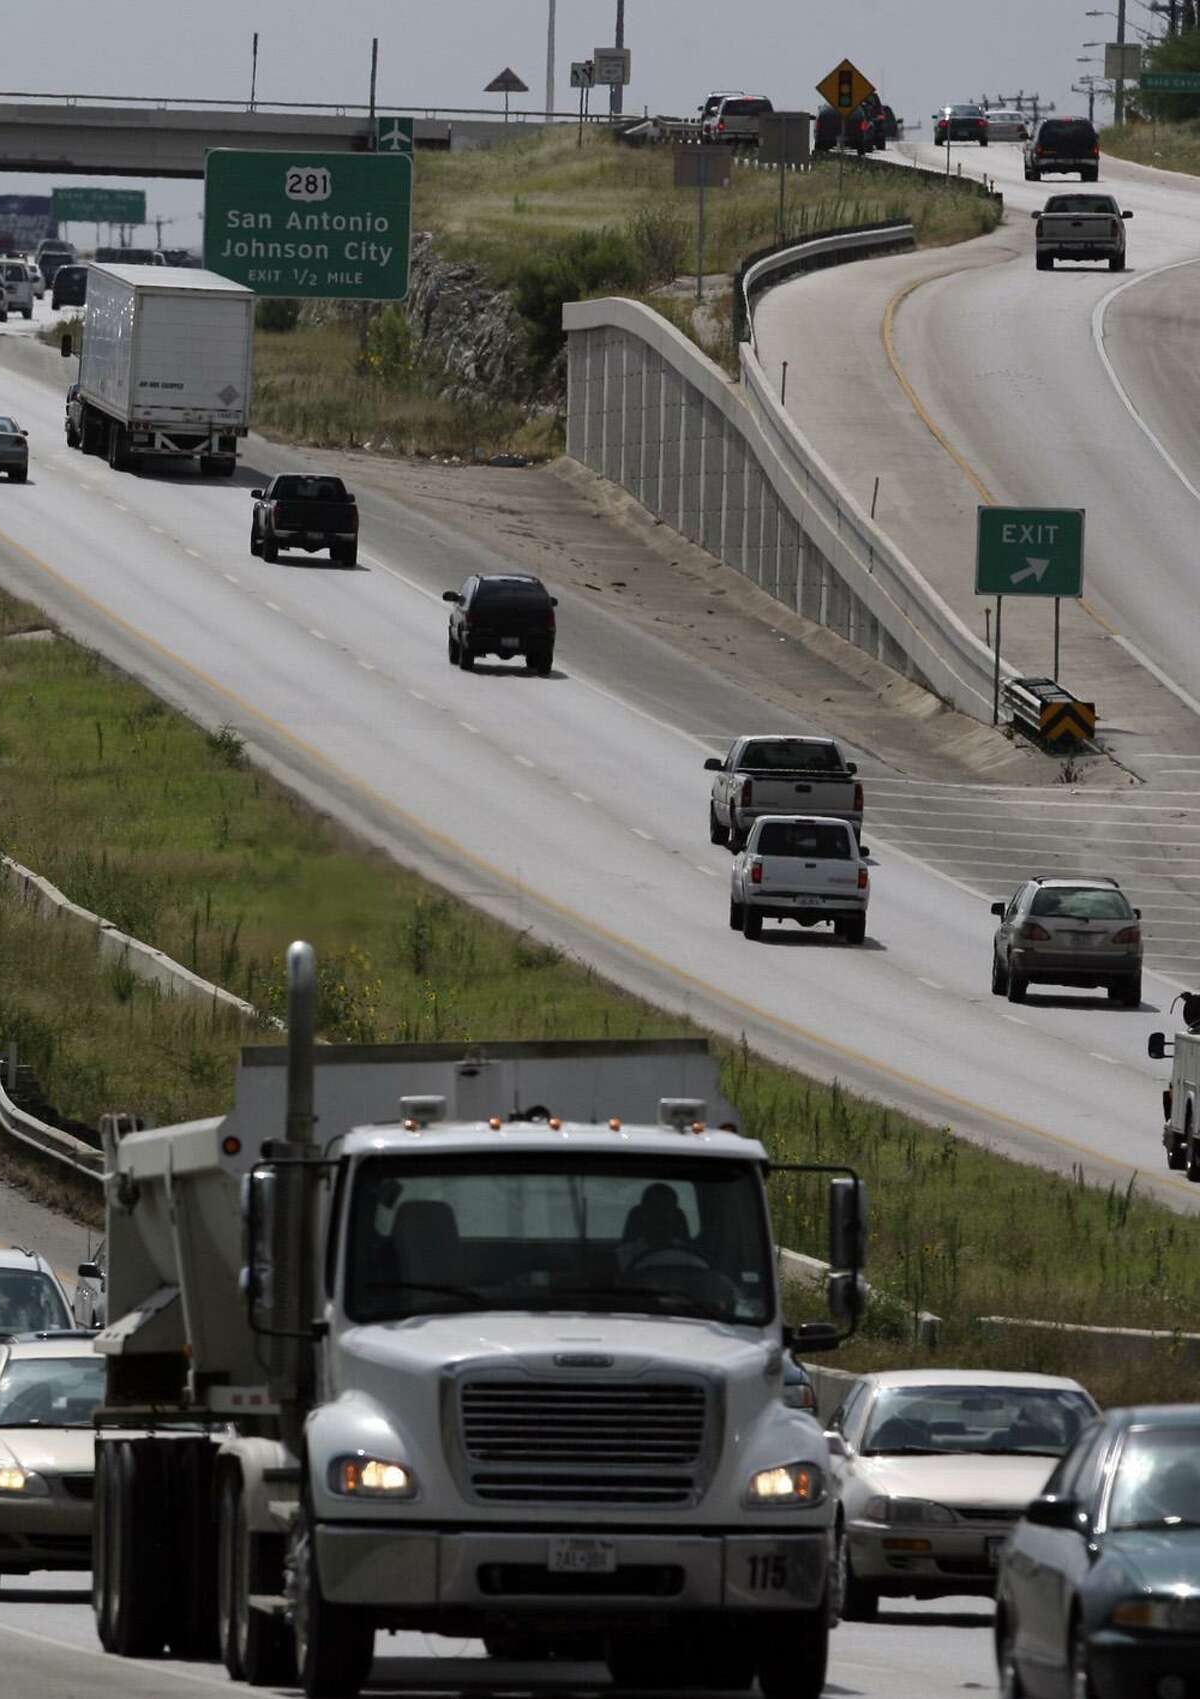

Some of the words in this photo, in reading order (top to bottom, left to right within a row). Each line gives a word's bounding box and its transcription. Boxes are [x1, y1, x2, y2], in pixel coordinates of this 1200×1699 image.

[288, 174, 328, 194] 281
[227, 210, 272, 230] San
[286, 211, 389, 232] Antonio
[221, 239, 329, 260] Johnson
[344, 241, 393, 267] City
[248, 269, 281, 283] EXIT
[327, 272, 363, 284] MILE
[1002, 524, 1059, 544] EXIT
[747, 1555, 786, 1590] 115
